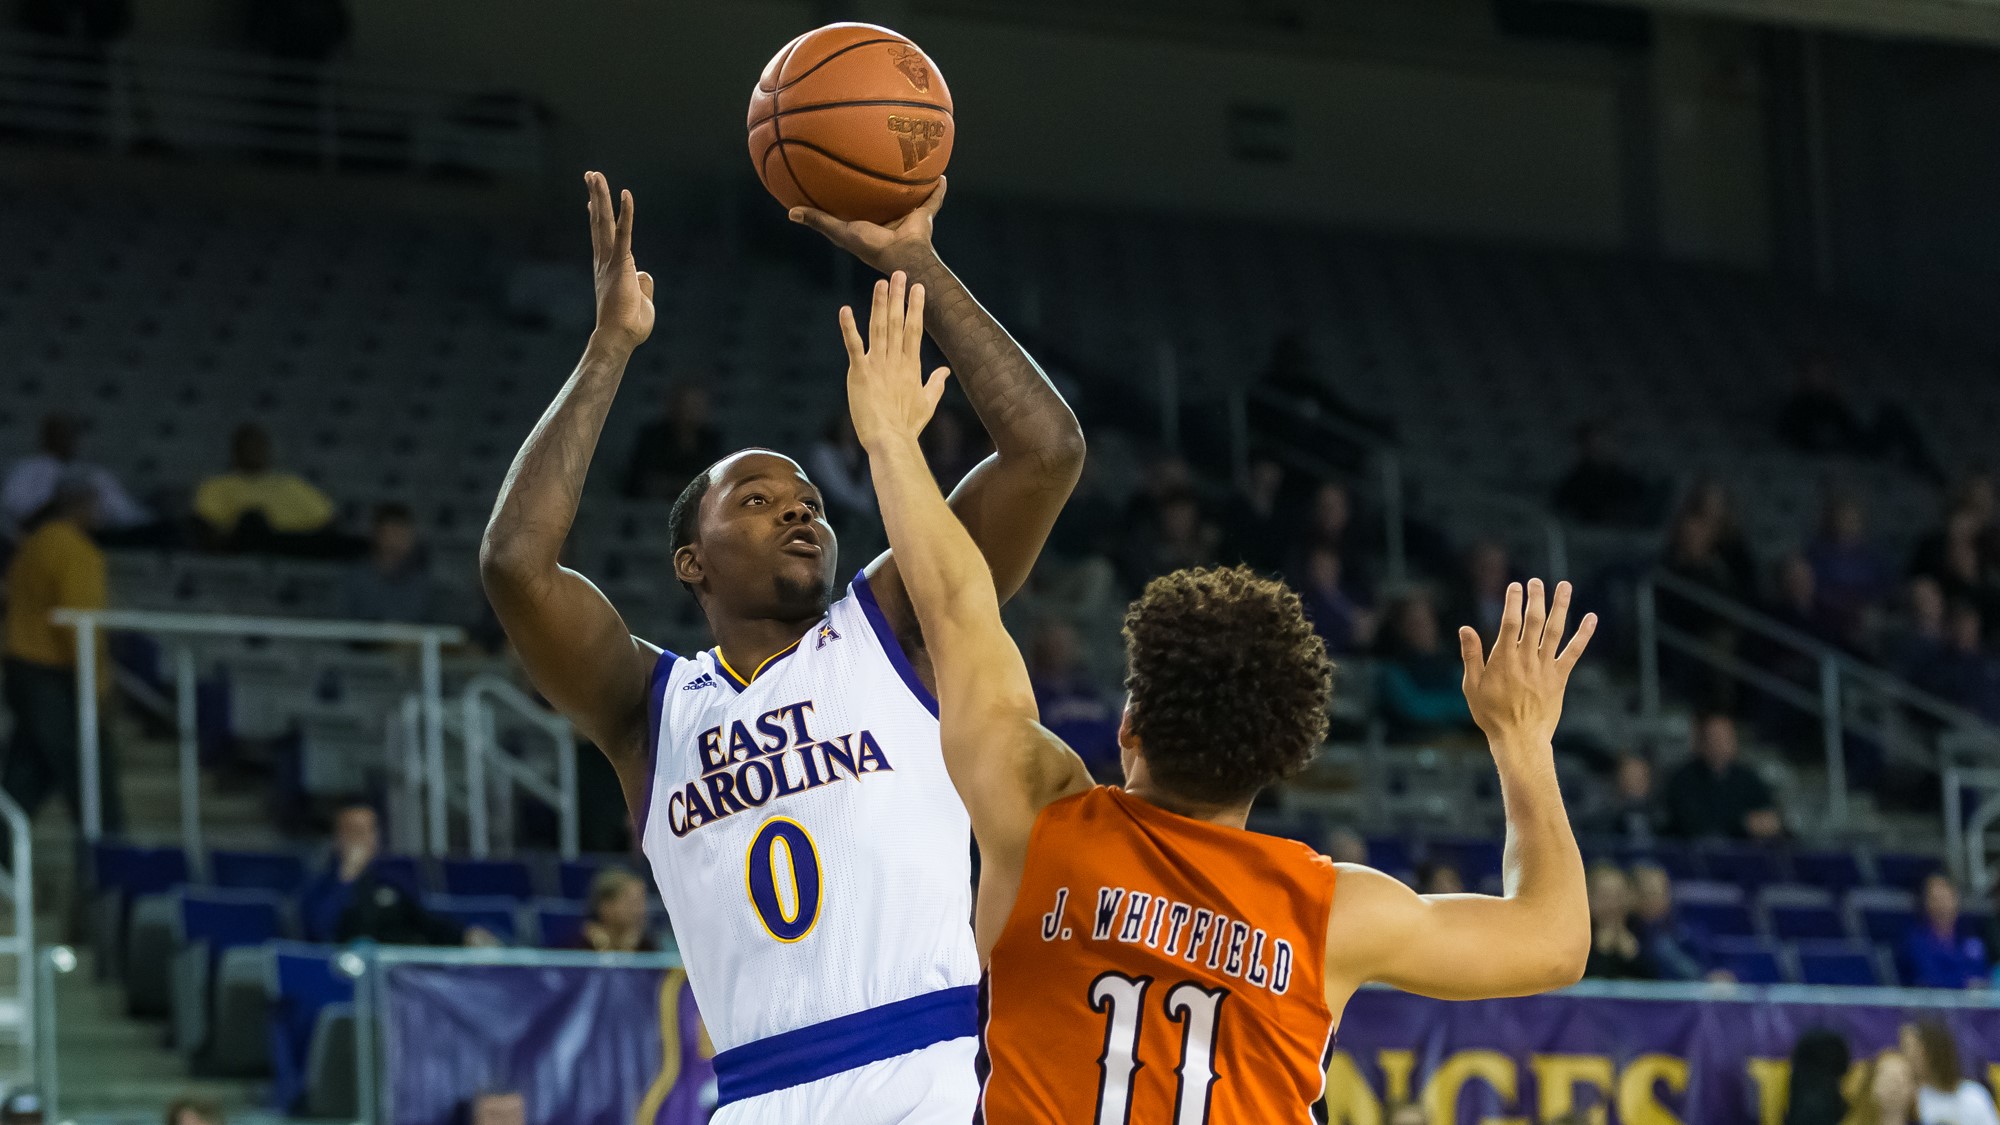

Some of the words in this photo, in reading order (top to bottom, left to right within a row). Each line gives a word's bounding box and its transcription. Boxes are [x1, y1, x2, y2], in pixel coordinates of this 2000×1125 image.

[682, 680, 718, 691] adidas
[697, 700, 816, 775] EAST
[668, 729, 894, 838] CAROLINA
[746, 815, 823, 943] 0
[1041, 887, 1073, 942] J.
[1092, 887, 1294, 996] WHITFIELD
[1087, 970, 1231, 1125] 11
